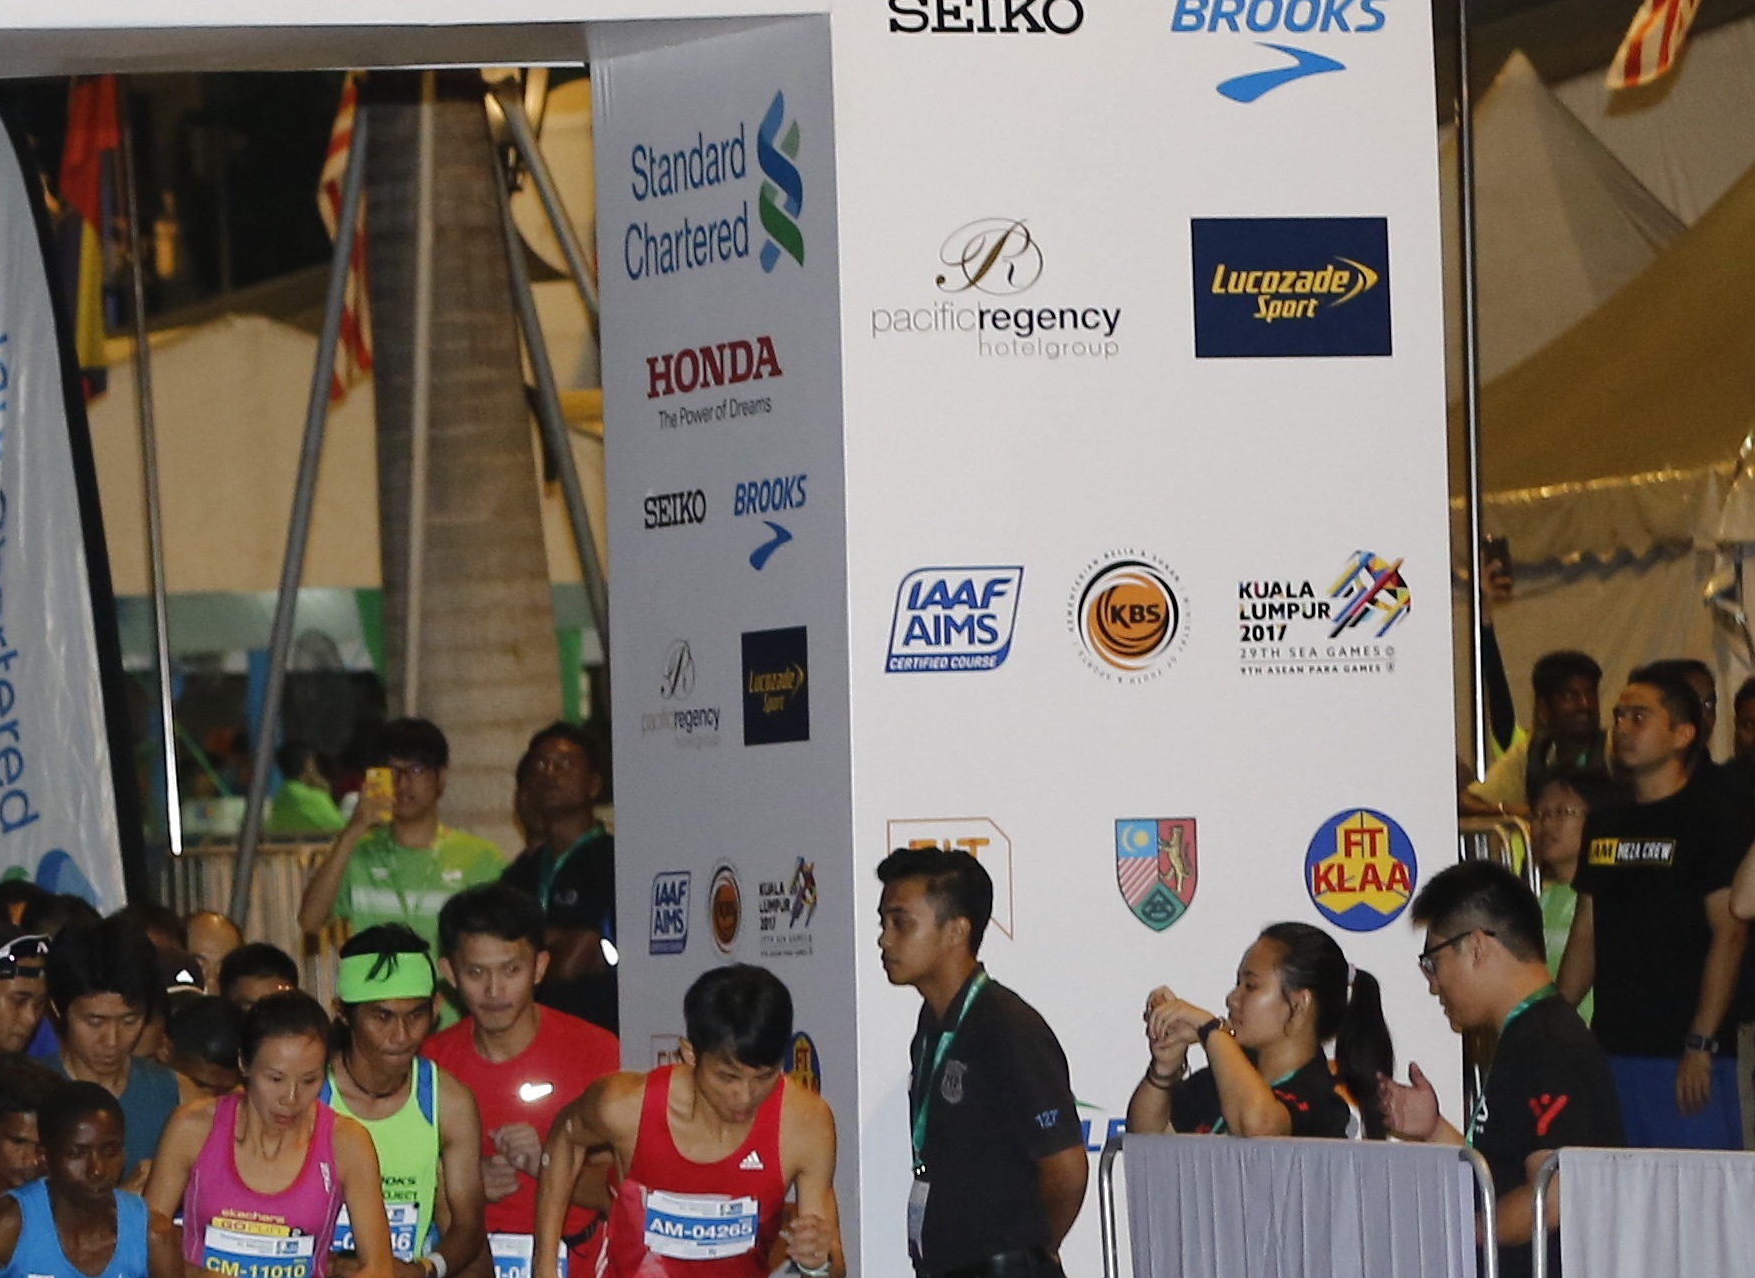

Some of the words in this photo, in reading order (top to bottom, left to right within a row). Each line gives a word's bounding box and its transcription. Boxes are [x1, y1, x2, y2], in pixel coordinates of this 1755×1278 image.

[631, 122, 747, 202] Standard
[624, 201, 750, 281] Chartered
[1211, 257, 1350, 296] Lucozade
[1253, 294, 1319, 325] Sport
[646, 335, 783, 400] HONDA
[658, 407, 678, 430] The
[679, 402, 714, 427] Power
[716, 399, 728, 422] of
[729, 394, 772, 419] Dreams
[644, 488, 707, 531] SEIKO
[734, 474, 808, 518] BROOKS
[907, 578, 1011, 611] IAAF
[1239, 581, 1314, 599] KUALA
[1110, 604, 1162, 630] KBS
[1240, 602, 1332, 620] LUMPUR
[902, 614, 1000, 648] AIMS
[1240, 624, 1287, 642] 2017
[889, 657, 948, 671] CERTIFIED
[949, 654, 998, 670] COURSE
[1326, 645, 1381, 658] GAMES
[1344, 826, 1384, 859] FT
[1313, 860, 1412, 894] KLAA
[655, 880, 688, 908] IAAF
[654, 908, 685, 935] AIMS
[1034, 1108, 1060, 1130] 127
[649, 1218, 753, 1240] AM-04265
